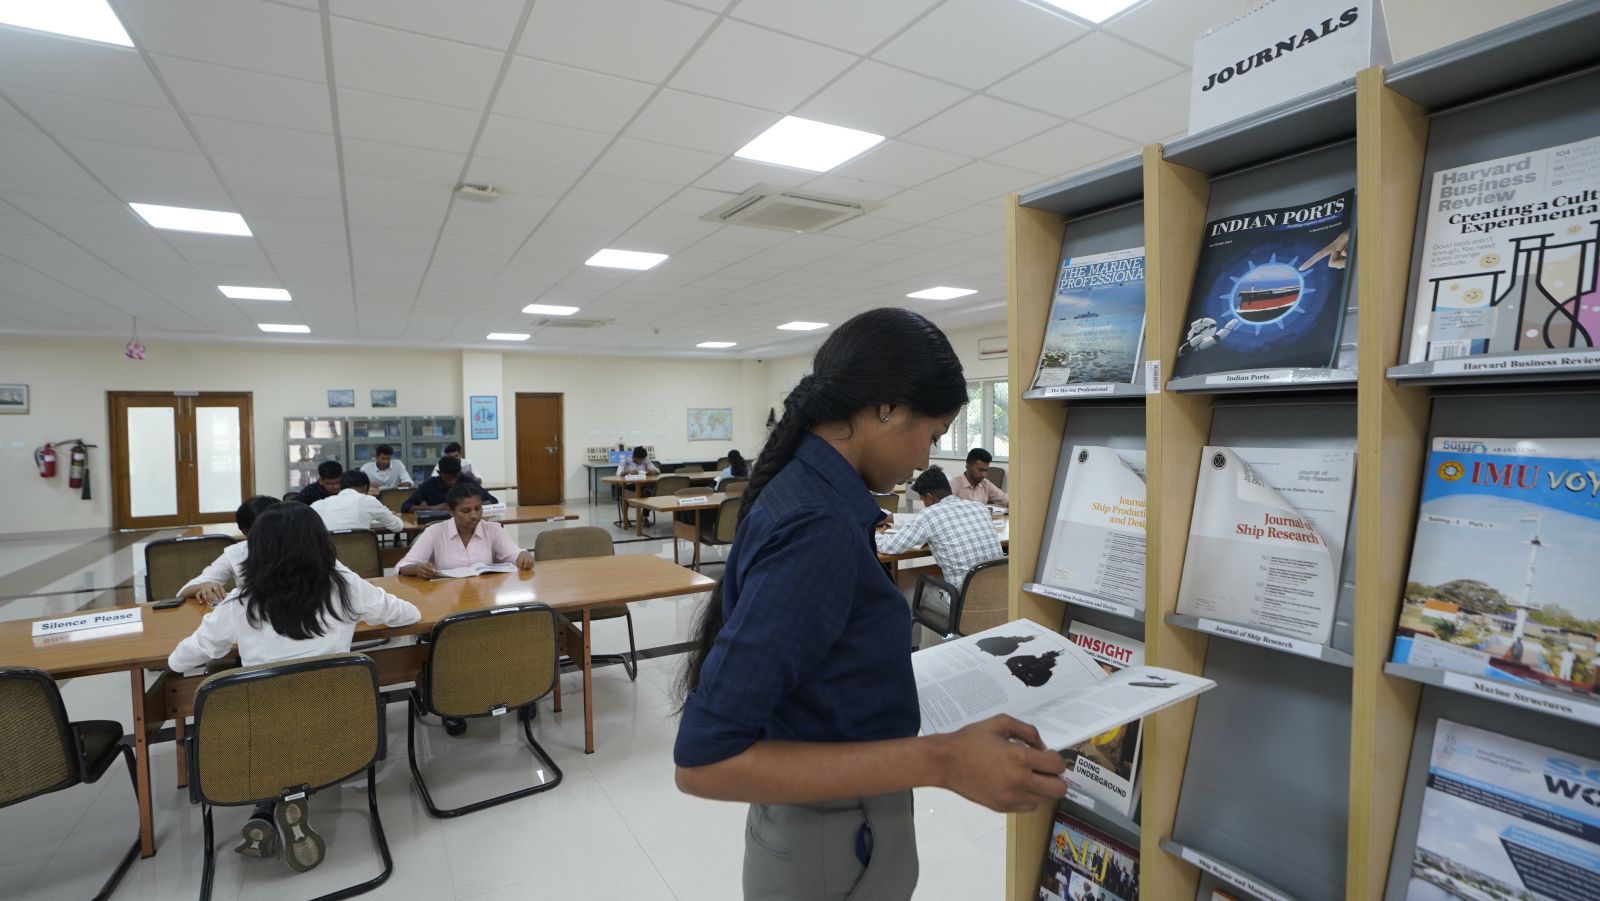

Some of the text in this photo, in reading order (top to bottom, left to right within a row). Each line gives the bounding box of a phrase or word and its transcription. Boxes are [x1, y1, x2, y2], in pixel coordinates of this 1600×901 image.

[1202, 7, 1358, 92] JOURNALS
[1441, 156, 1532, 186] Harvard
[1440, 172, 1537, 199] Business
[1438, 189, 1517, 213] Review
[1448, 189, 1600, 225] Creating a Cult
[1210, 197, 1345, 237] INDIAN PORTS
[1460, 203, 1600, 235] Experimenta
[1060, 268, 1145, 290] PROFESSIONA
[1063, 257, 1143, 279] THE MARINE
[1463, 355, 1600, 370] Harvard Business Review
[1470, 461, 1540, 490] IMU
[1091, 502, 1111, 515] Ship
[1109, 516, 1126, 525] and
[1264, 513, 1304, 529] Journal
[1236, 523, 1320, 545] Ship Research
[41, 612, 133, 631] Silence Please
[1077, 634, 1133, 663] INSIGHT
[1214, 625, 1294, 649] Journal of Ship Research
[1473, 681, 1573, 714] Marine Structures
[1078, 759, 1100, 774] GOING
[1076, 766, 1127, 798] UNDERGROUND
